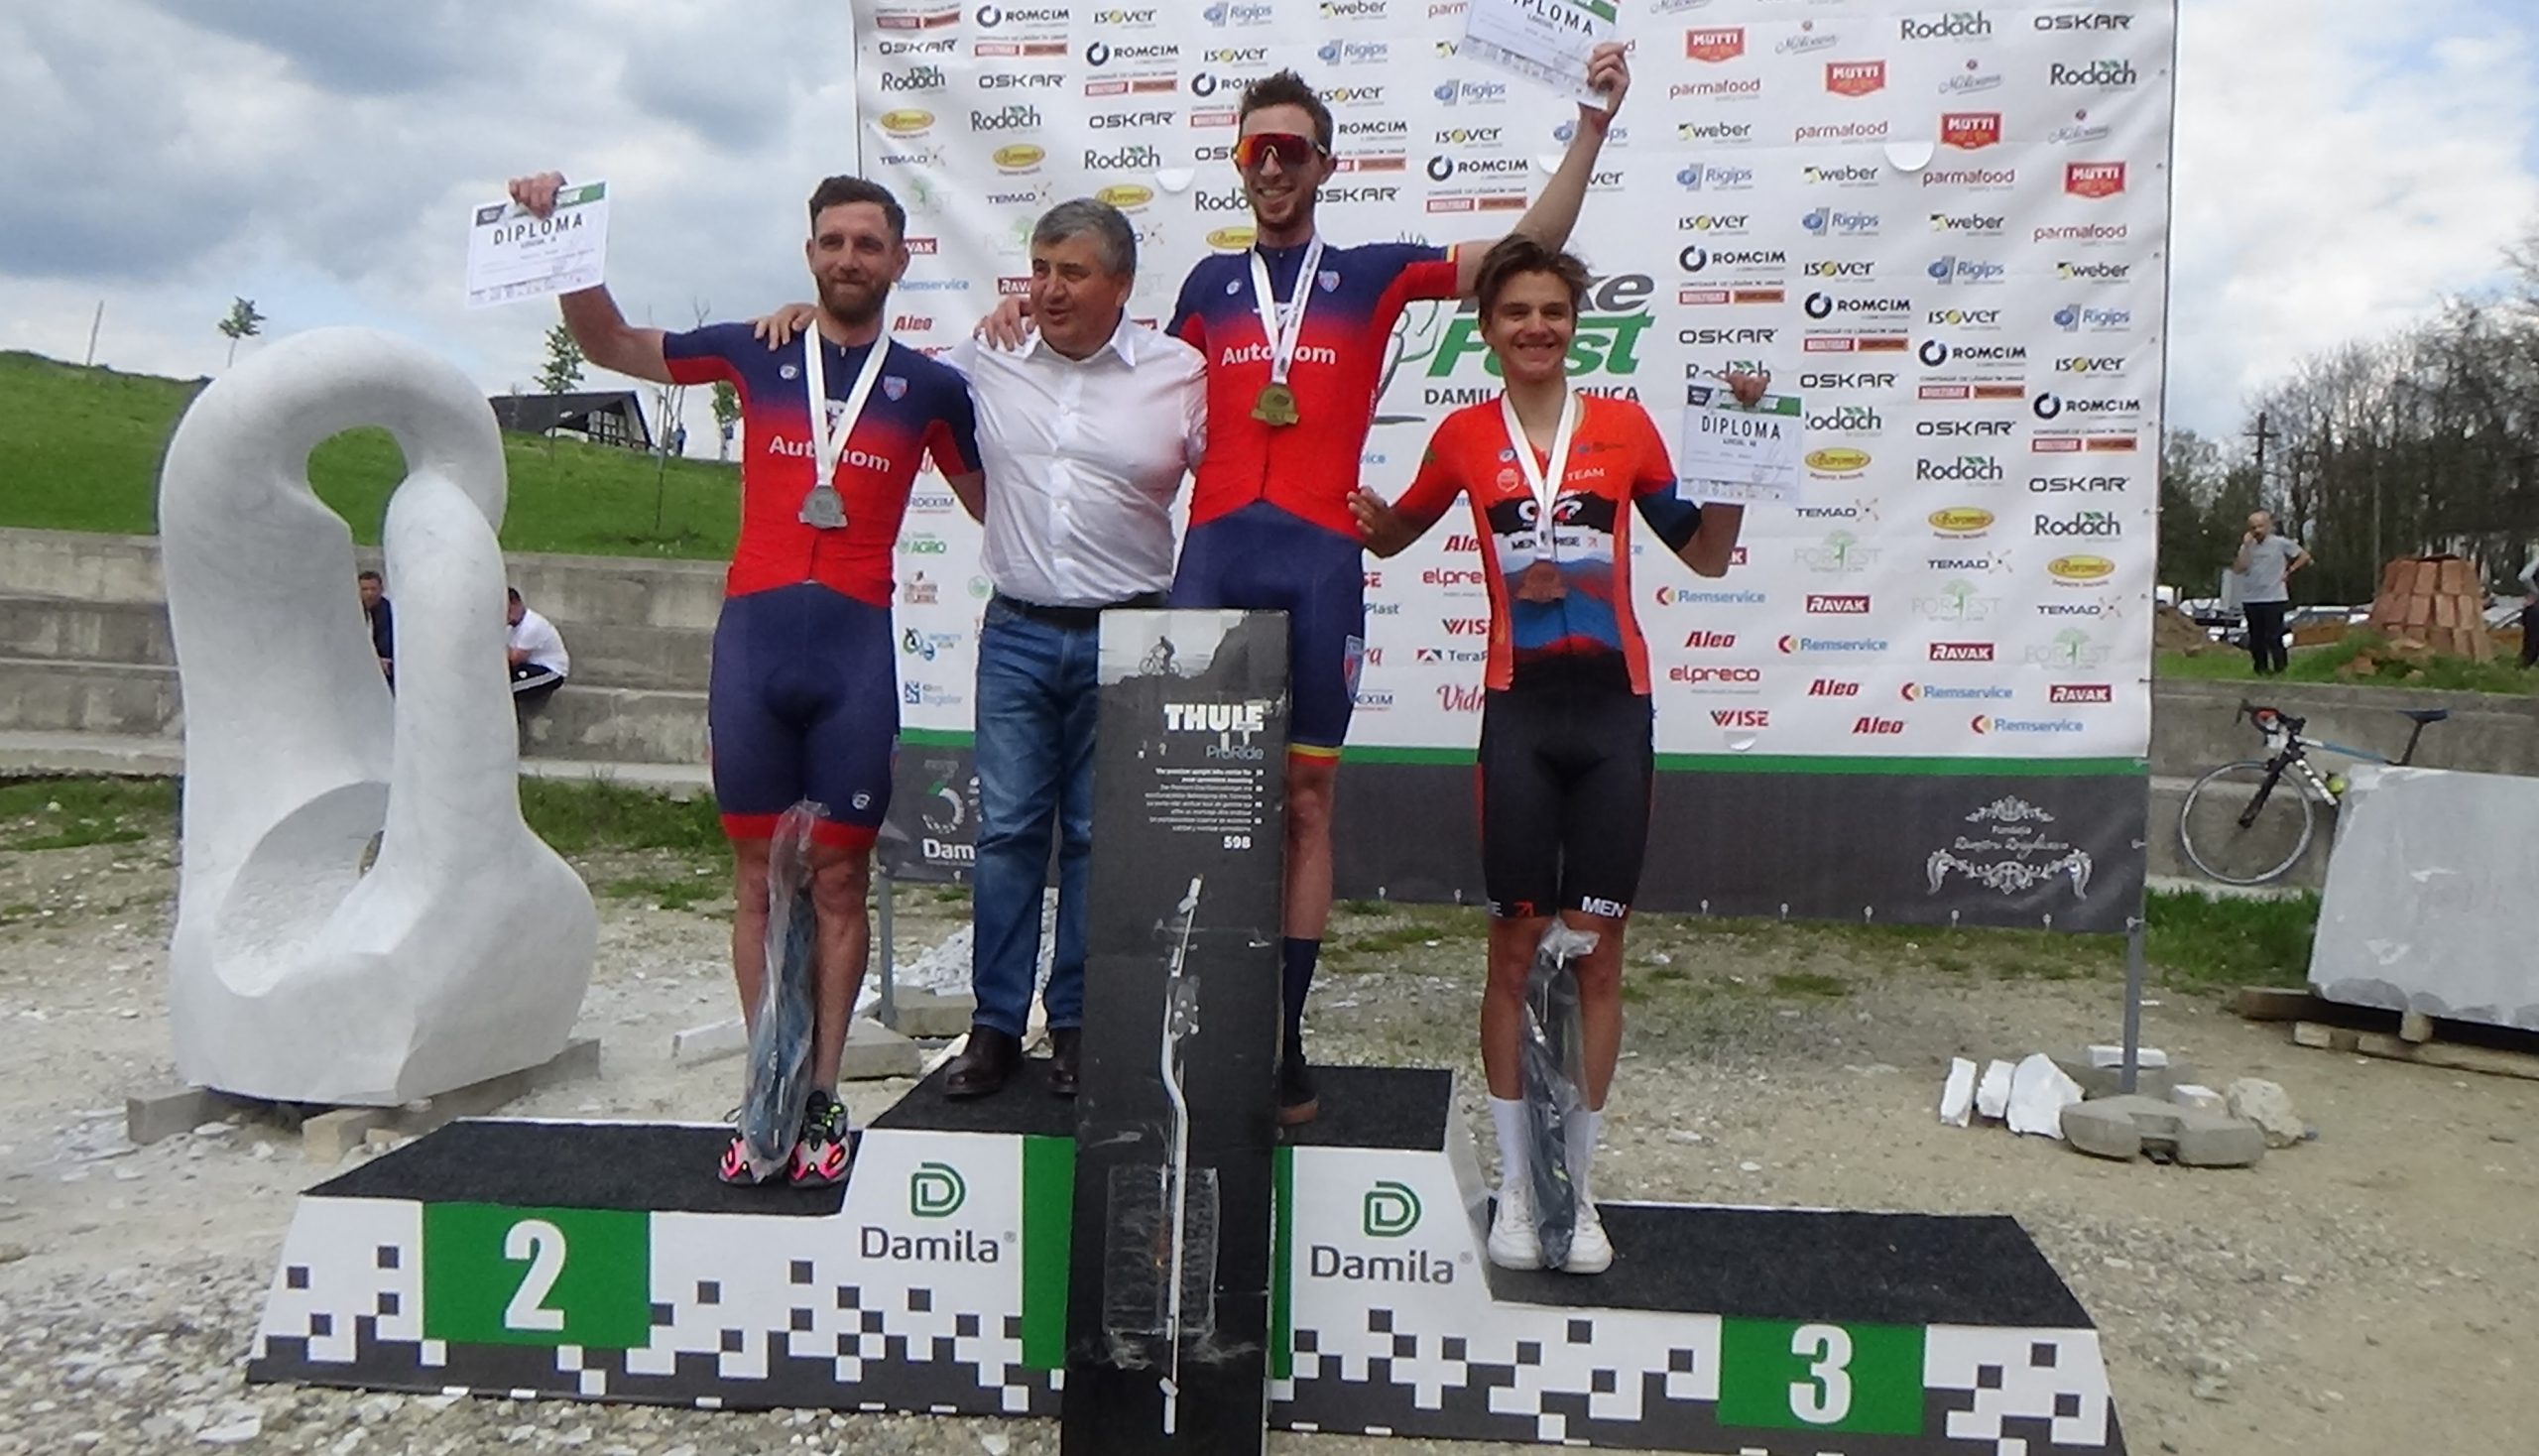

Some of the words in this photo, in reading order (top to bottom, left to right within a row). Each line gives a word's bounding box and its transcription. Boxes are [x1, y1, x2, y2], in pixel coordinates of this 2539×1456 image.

[1006, 9, 1069, 22] ROMCIM
[1094, 9, 1157, 24] isover
[1230, 4, 1272, 21] Rigips
[1334, 0, 1387, 16] weber
[1900, 11, 1992, 40] Rodach
[2034, 14, 2134, 31] OSKAR
[879, 39, 957, 56] OSKAR
[1692, 32, 1739, 46] MUTTI
[1114, 45, 1179, 58] ROMCIM
[1204, 48, 1269, 63] isover
[1344, 42, 1388, 59] Rigips
[881, 65, 945, 91] Rodach
[1832, 65, 1879, 79] MUTTI
[2050, 60, 2136, 85] Rodach
[979, 74, 1065, 89] OSKAR
[1461, 80, 1506, 98] Rigips
[1669, 78, 1760, 99] parmafood
[971, 105, 1041, 132] Rodach
[1089, 111, 1176, 129] OSKAR
[1948, 116, 1995, 131] MUTTI
[1339, 120, 1407, 135] ROMCIM
[1435, 127, 1502, 144] isover
[1693, 121, 1752, 138] weber
[1795, 120, 1888, 142] parmafood
[1084, 146, 1160, 170] Rodach
[1458, 159, 1527, 173] ROMCIM
[1705, 168, 1753, 184] Rigips
[1819, 165, 1878, 182] weber
[1922, 169, 2015, 186] parmafood
[2072, 167, 2119, 181] MUTTI
[1195, 187, 1250, 211] Roda
[493, 212, 583, 245] DIPLOMA
[1678, 214, 1749, 231] isover
[1832, 211, 1879, 230] Rigips
[1946, 213, 2004, 229] weber
[2033, 223, 2127, 243] parmafood
[1712, 250, 1786, 264] ROMCIM
[1803, 261, 1874, 277] isover
[1957, 260, 2004, 280] Rigips
[2073, 262, 2129, 278] weber
[1001, 280, 1030, 294] RAV
[1837, 299, 1911, 311] ROMCIM
[1928, 309, 2000, 324] isover
[2082, 306, 2130, 325] Rigips
[1679, 328, 1778, 344] OSKAR
[1952, 346, 2026, 359] ROMCIM
[2055, 356, 2125, 373] isover
[1800, 373, 1898, 389] OSKAR
[2066, 399, 2140, 413] ROMCIM
[1701, 415, 1781, 440] DIPLOMA
[1916, 421, 2016, 436] OSKAR
[1567, 468, 1605, 481] TEAM
[1916, 454, 2003, 481] Rodach
[2029, 476, 2130, 492] OSKAR
[2034, 511, 2120, 537] Rodach
[1423, 567, 1483, 587] elpre
[1678, 590, 1766, 604] Remservice
[1809, 596, 1868, 613] RAVAK
[1442, 619, 1487, 635] WIS
[1800, 638, 1888, 652] Remservice
[1933, 644, 1990, 661] RAVAK
[1669, 665, 1760, 684] elpreco
[1924, 684, 2013, 699] Remservice
[2053, 686, 2109, 702] RAVAK
[1164, 703, 1265, 732] THULE
[1710, 710, 1769, 726] WISE
[1995, 718, 2084, 733] Remservice
[1206, 745, 1265, 761] ProRide
[922, 838, 975, 861] Dam
[1223, 835, 1251, 850] 598
[1581, 896, 1627, 918] MEN
[504, 1219, 566, 1331] 2
[1789, 1324, 1853, 1424] 3
